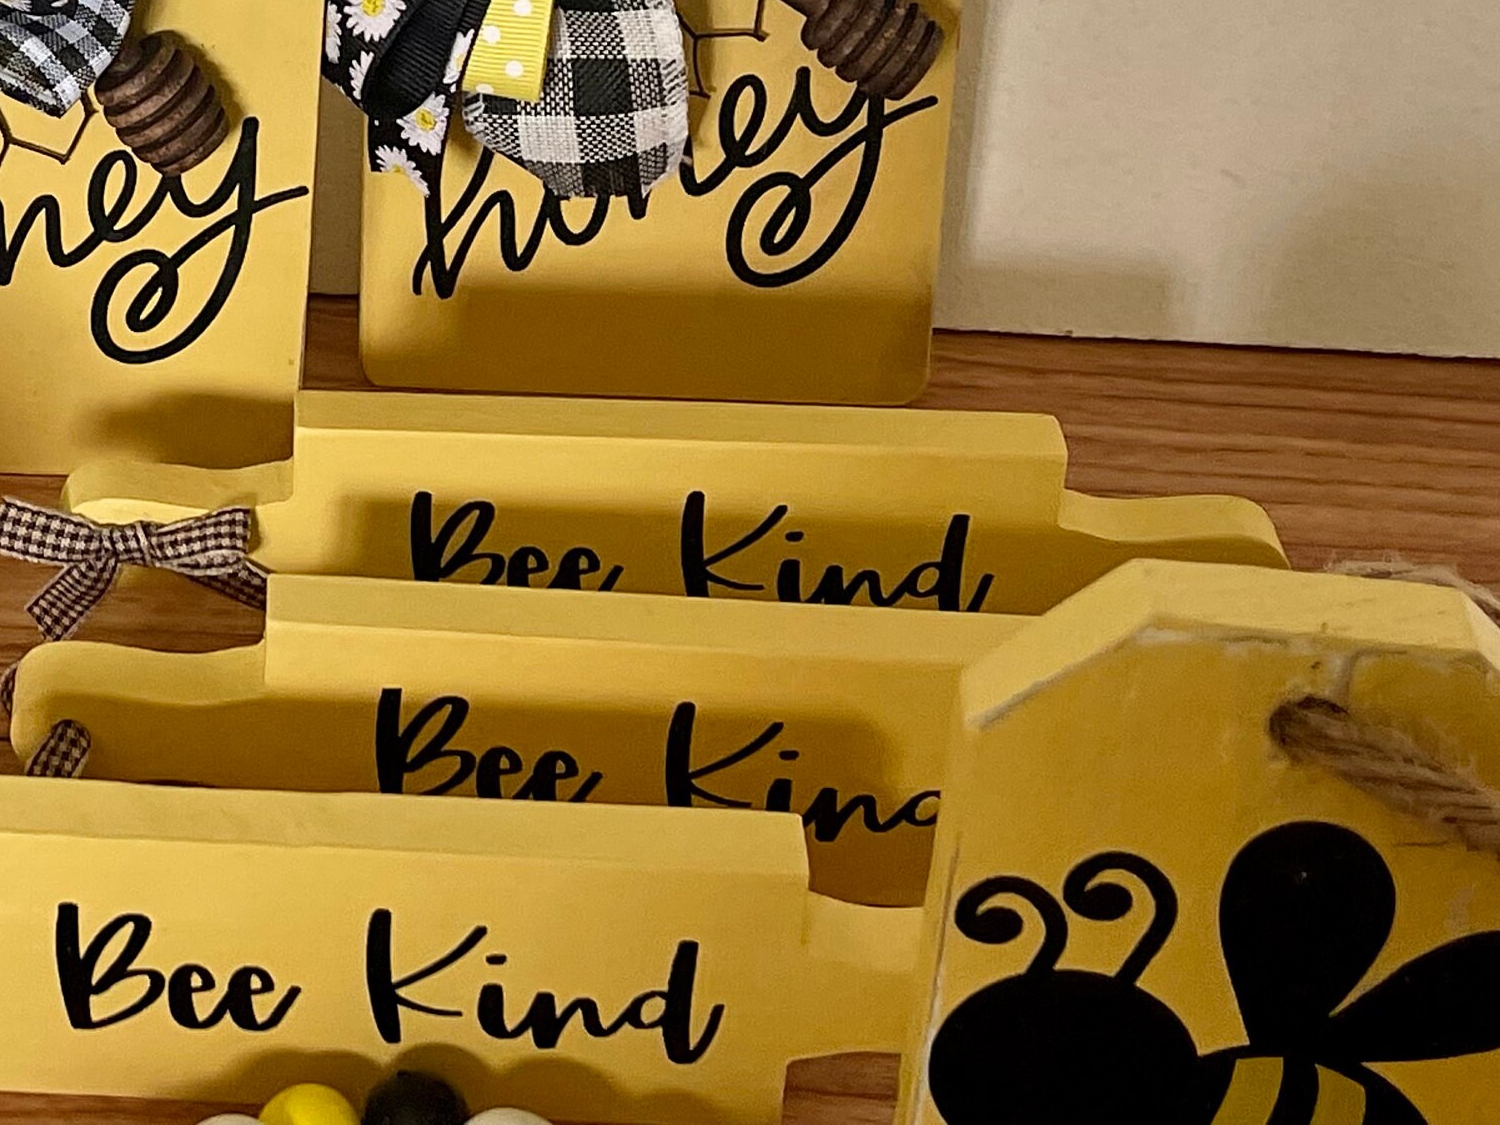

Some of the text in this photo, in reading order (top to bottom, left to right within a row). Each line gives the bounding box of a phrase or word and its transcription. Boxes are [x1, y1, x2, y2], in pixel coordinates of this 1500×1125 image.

[409, 490, 995, 613] Bee Kind
[374, 687, 603, 803] Bee
[54, 901, 725, 1065] Bee Kind
